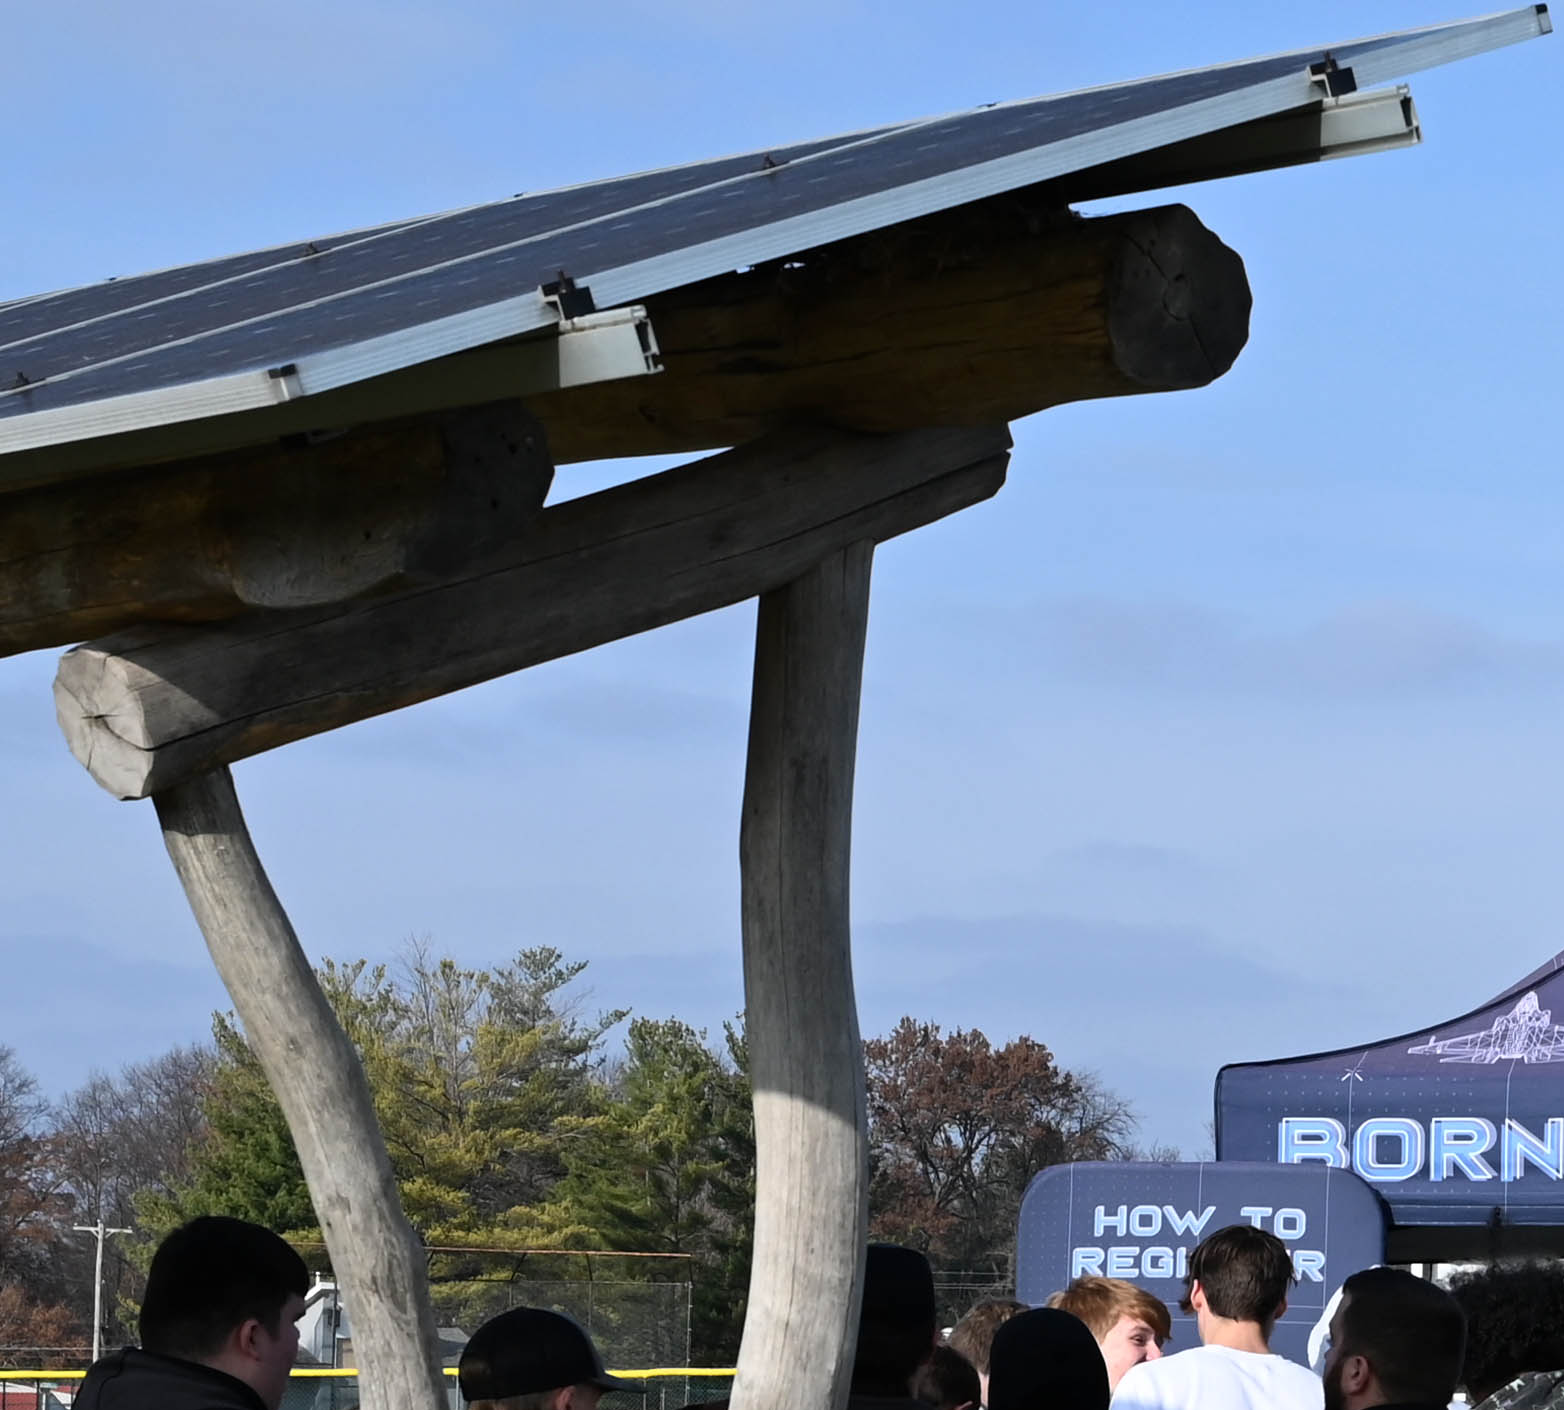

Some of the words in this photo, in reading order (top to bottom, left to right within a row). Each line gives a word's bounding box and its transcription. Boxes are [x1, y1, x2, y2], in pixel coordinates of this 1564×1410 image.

[1094, 1205, 1216, 1237] HOW
[1240, 1206, 1307, 1239] TO
[1072, 1246, 1326, 1282] REGIR
